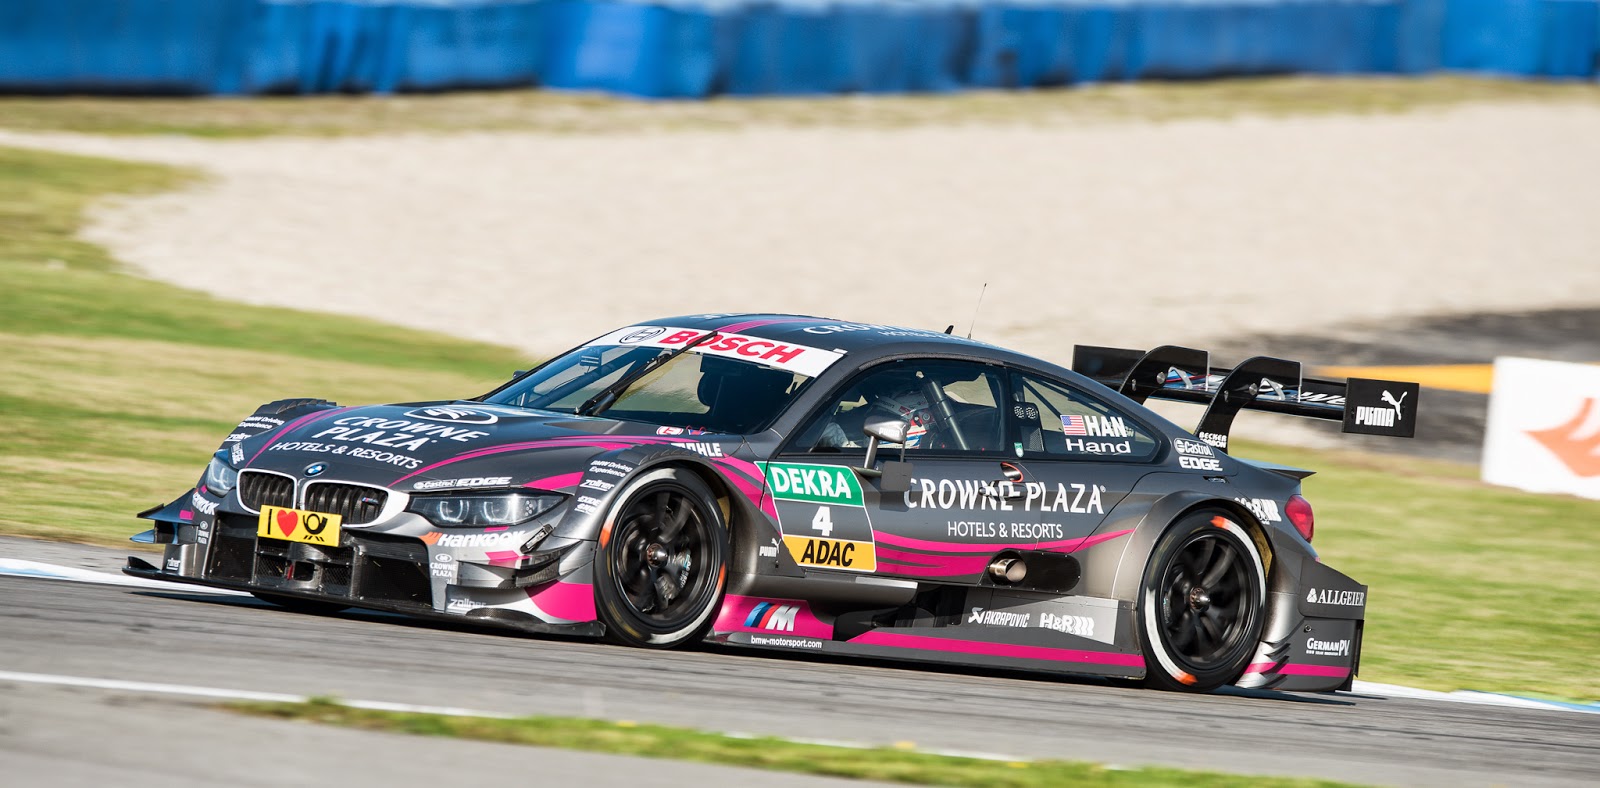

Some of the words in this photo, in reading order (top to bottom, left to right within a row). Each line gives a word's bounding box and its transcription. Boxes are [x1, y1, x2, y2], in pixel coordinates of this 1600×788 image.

[657, 331, 806, 363] BOSCH
[1355, 406, 1395, 427] PUMA
[333, 417, 490, 442] CROWNE
[1084, 415, 1127, 437] HAN
[1199, 431, 1227, 441] BECKER
[1066, 438, 1131, 453] Hand
[1184, 441, 1213, 455] Castrol
[269, 442, 335, 453] HOTELS
[332, 446, 348, 454] &
[349, 447, 423, 469] RESORTS
[1178, 456, 1223, 471] EDGE
[589, 466, 626, 478] Experience
[608, 461, 633, 473] Driving
[456, 477, 512, 487] EDGE
[769, 467, 852, 499] DEKRA
[267, 508, 273, 535] I
[811, 506, 833, 537] 4
[947, 521, 996, 538] HOTELS
[999, 522, 1009, 538] &
[1011, 522, 1063, 539] RESORTS
[800, 540, 855, 567] ADAC
[430, 562, 457, 571] CROWNE
[432, 570, 453, 578] PLAZA
[1317, 589, 1365, 606] ALLGEIER
[750, 635, 823, 648] bmw-motorsport.com
